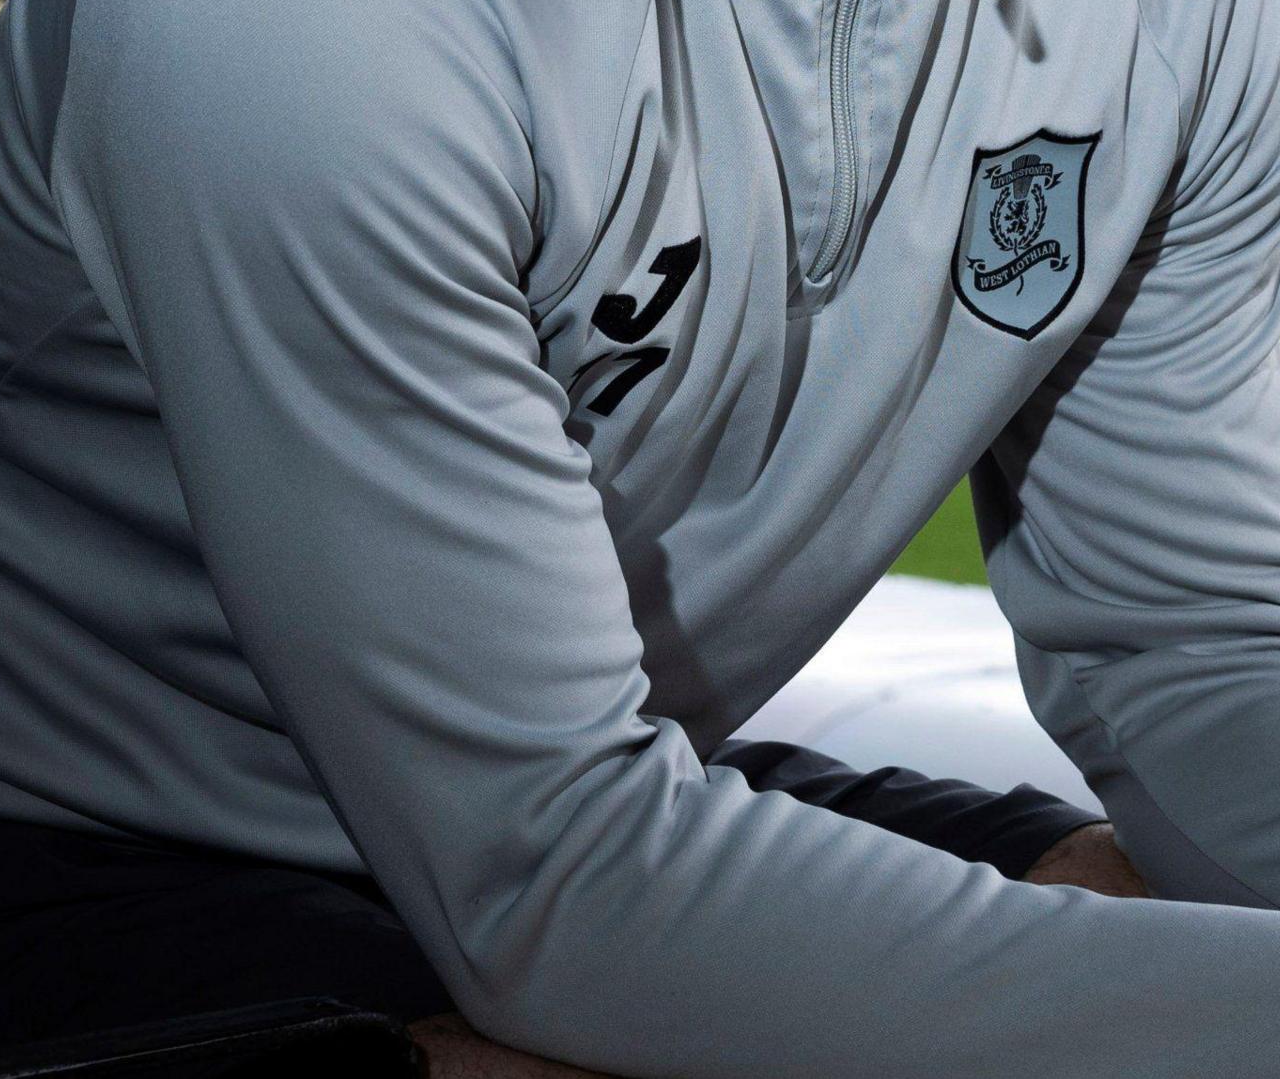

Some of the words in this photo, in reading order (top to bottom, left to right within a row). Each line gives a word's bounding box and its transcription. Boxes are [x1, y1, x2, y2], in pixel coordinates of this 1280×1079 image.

[992, 166, 1041, 187] LIVINGSTON
[980, 270, 1009, 288] WEST
[1011, 242, 1056, 275] LOTHIAN
